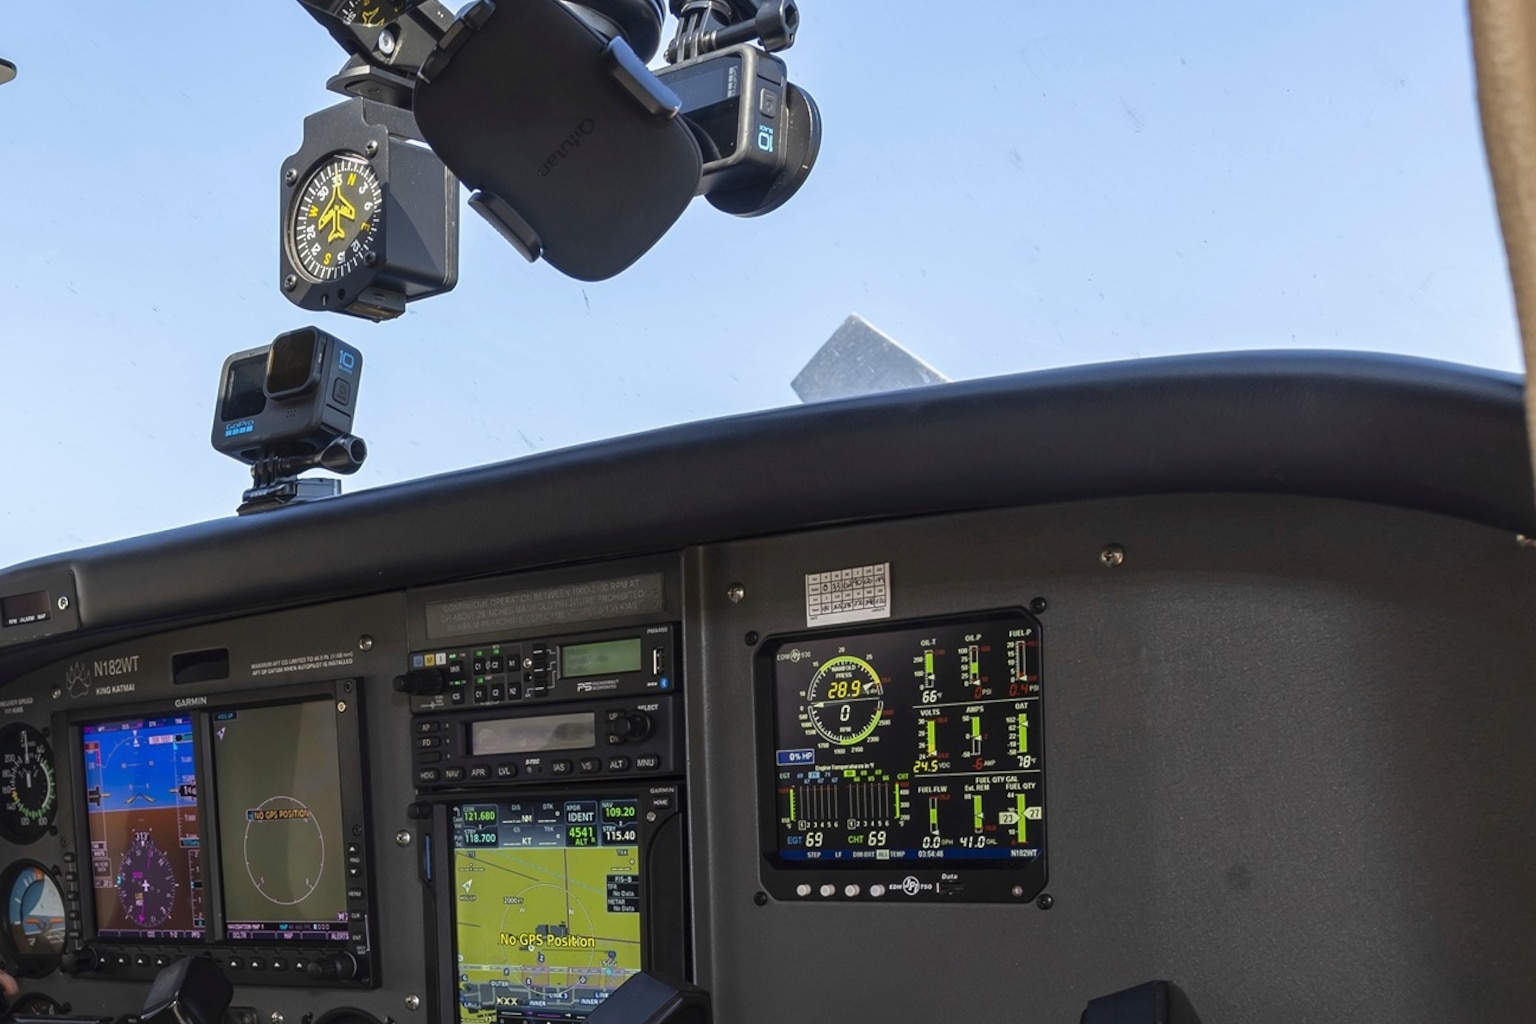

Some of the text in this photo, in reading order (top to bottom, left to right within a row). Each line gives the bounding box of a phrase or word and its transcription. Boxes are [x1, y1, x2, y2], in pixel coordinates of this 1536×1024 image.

[758, 131, 774, 153] 10
[347, 173, 357, 186] N
[317, 186, 329, 201] 30
[359, 182, 369, 195] 3
[309, 205, 319, 217] W
[364, 202, 373, 211] 6
[324, 253, 332, 265] S
[340, 350, 354, 369] 10
[225, 420, 255, 430] GoPro
[94, 656, 139, 676] N182WT
[96, 684, 135, 695] KING KATMAI
[828, 680, 861, 699] 28.9
[175, 697, 207, 707] GARMIN
[840, 705, 851, 721] 0
[920, 708, 940, 717] VOLTS
[966, 705, 984, 713] AMPS
[609, 760, 623, 769] ALT
[637, 758, 654, 767] MNU
[913, 760, 939, 773] 24.5
[446, 769, 460, 778] NAV
[471, 767, 485, 777] APR
[254, 808, 309, 820] NO GPS POSITION
[464, 811, 496, 821] 121.680
[568, 812, 594, 822] IDENT
[606, 806, 635, 817] 109.20
[1029, 809, 1040, 818] 27
[1003, 814, 1013, 823] 23
[569, 827, 593, 838] 4541
[606, 830, 636, 841] 115.40
[465, 834, 496, 843] 118.700
[522, 837, 532, 845] KT
[805, 832, 823, 847] 69
[848, 831, 886, 846] CHT 69
[923, 836, 941, 848] 0.0
[960, 836, 985, 848] 41.0
[500, 933, 595, 948] No GPS Position
